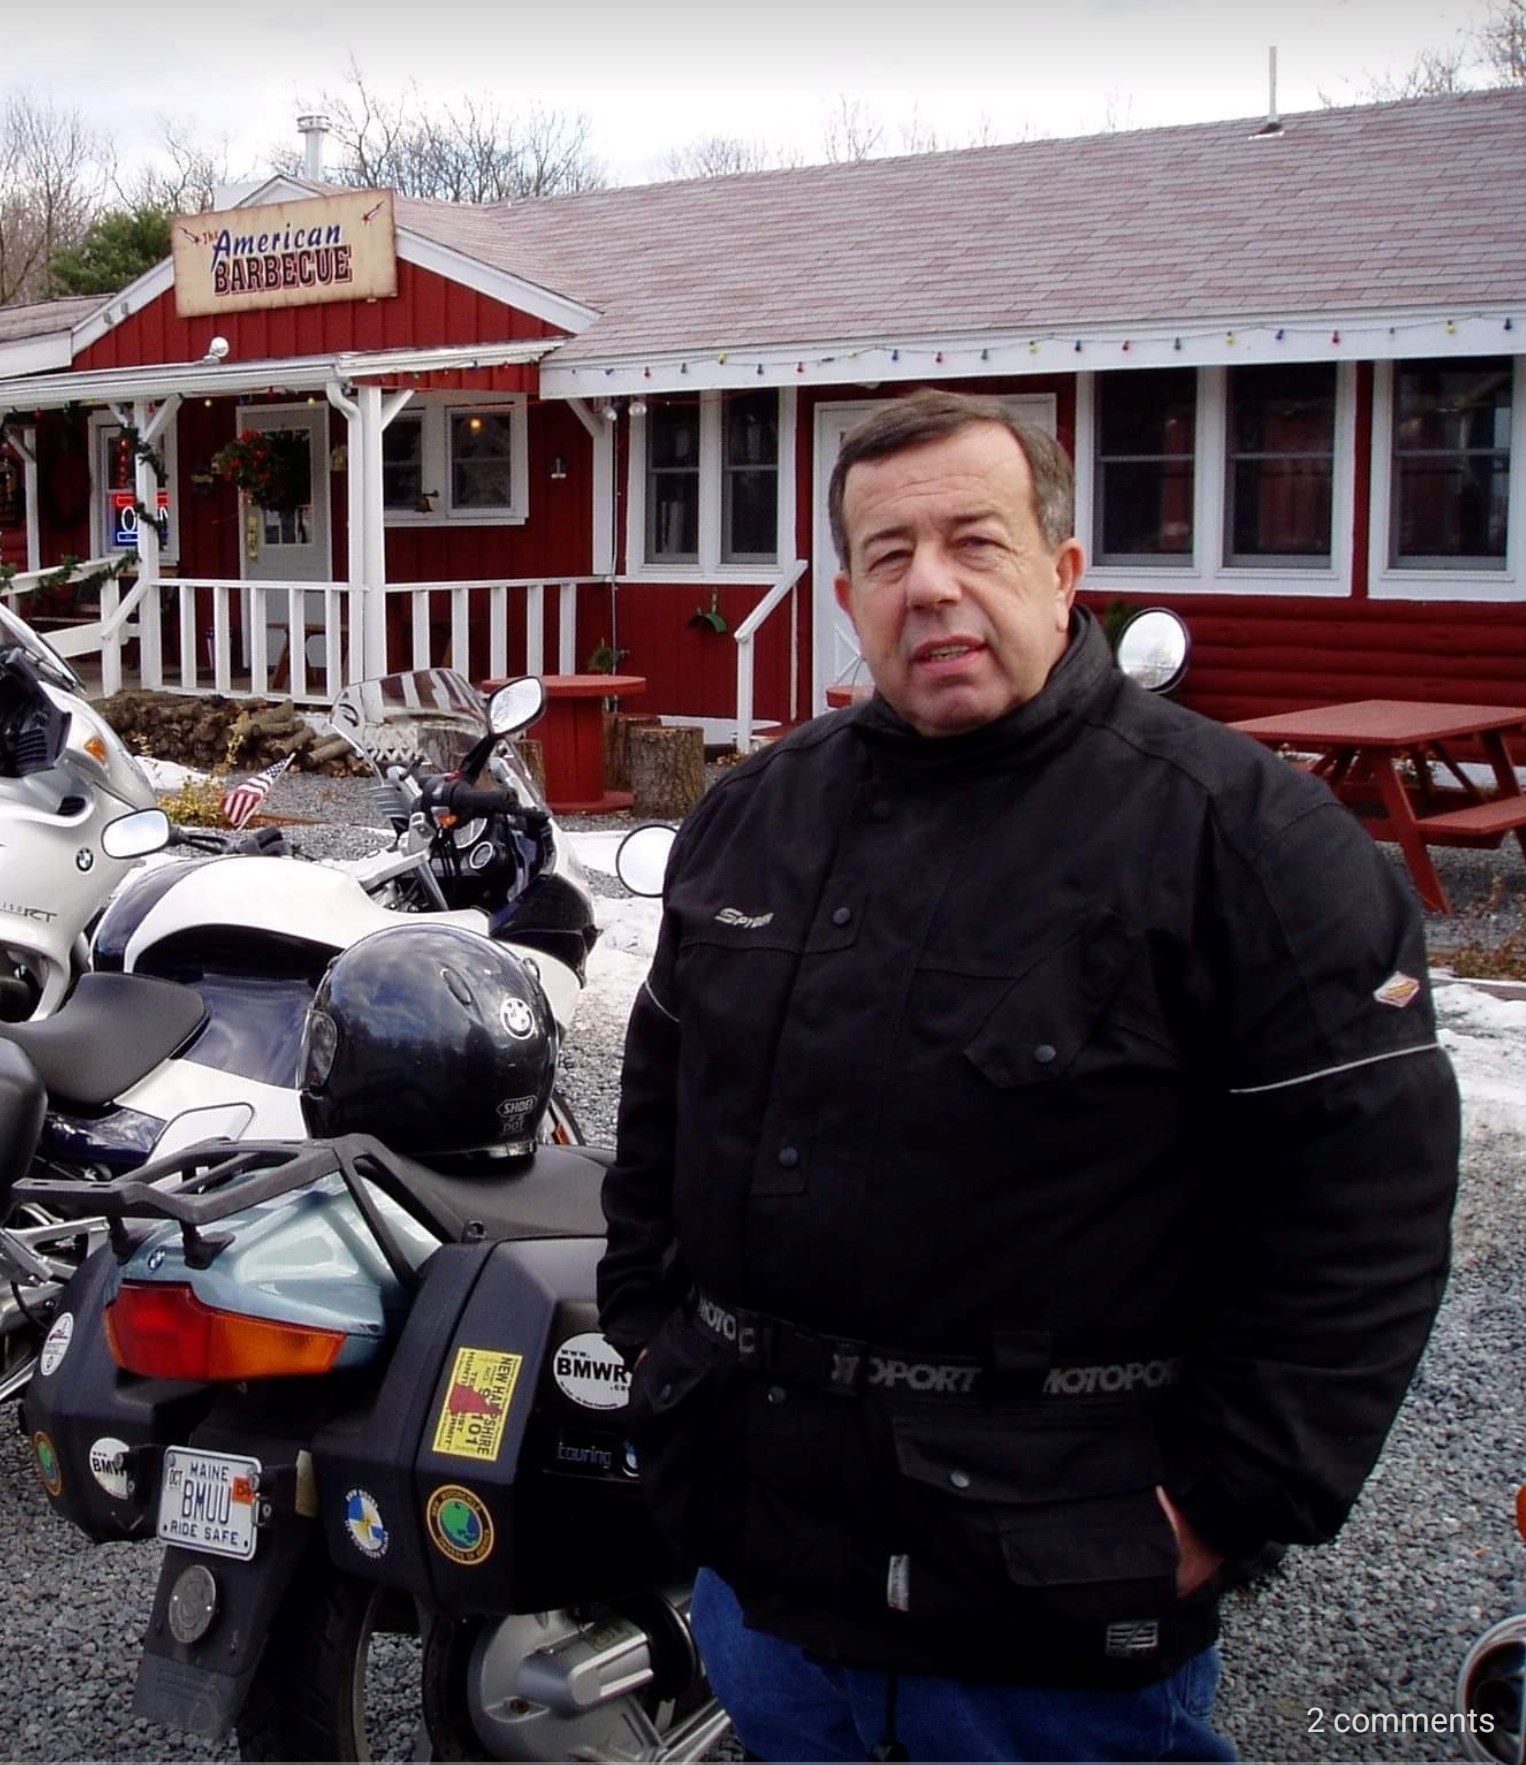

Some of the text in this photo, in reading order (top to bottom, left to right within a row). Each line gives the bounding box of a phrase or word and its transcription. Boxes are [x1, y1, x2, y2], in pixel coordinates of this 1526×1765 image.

[211, 222, 341, 272] American
[214, 244, 353, 297] BARBECUE
[495, 1355, 514, 1383] NEW
[558, 1442, 613, 1470] touring
[190, 1462, 229, 1482] MAINE
[170, 1519, 239, 1546] RIDE SAFE
